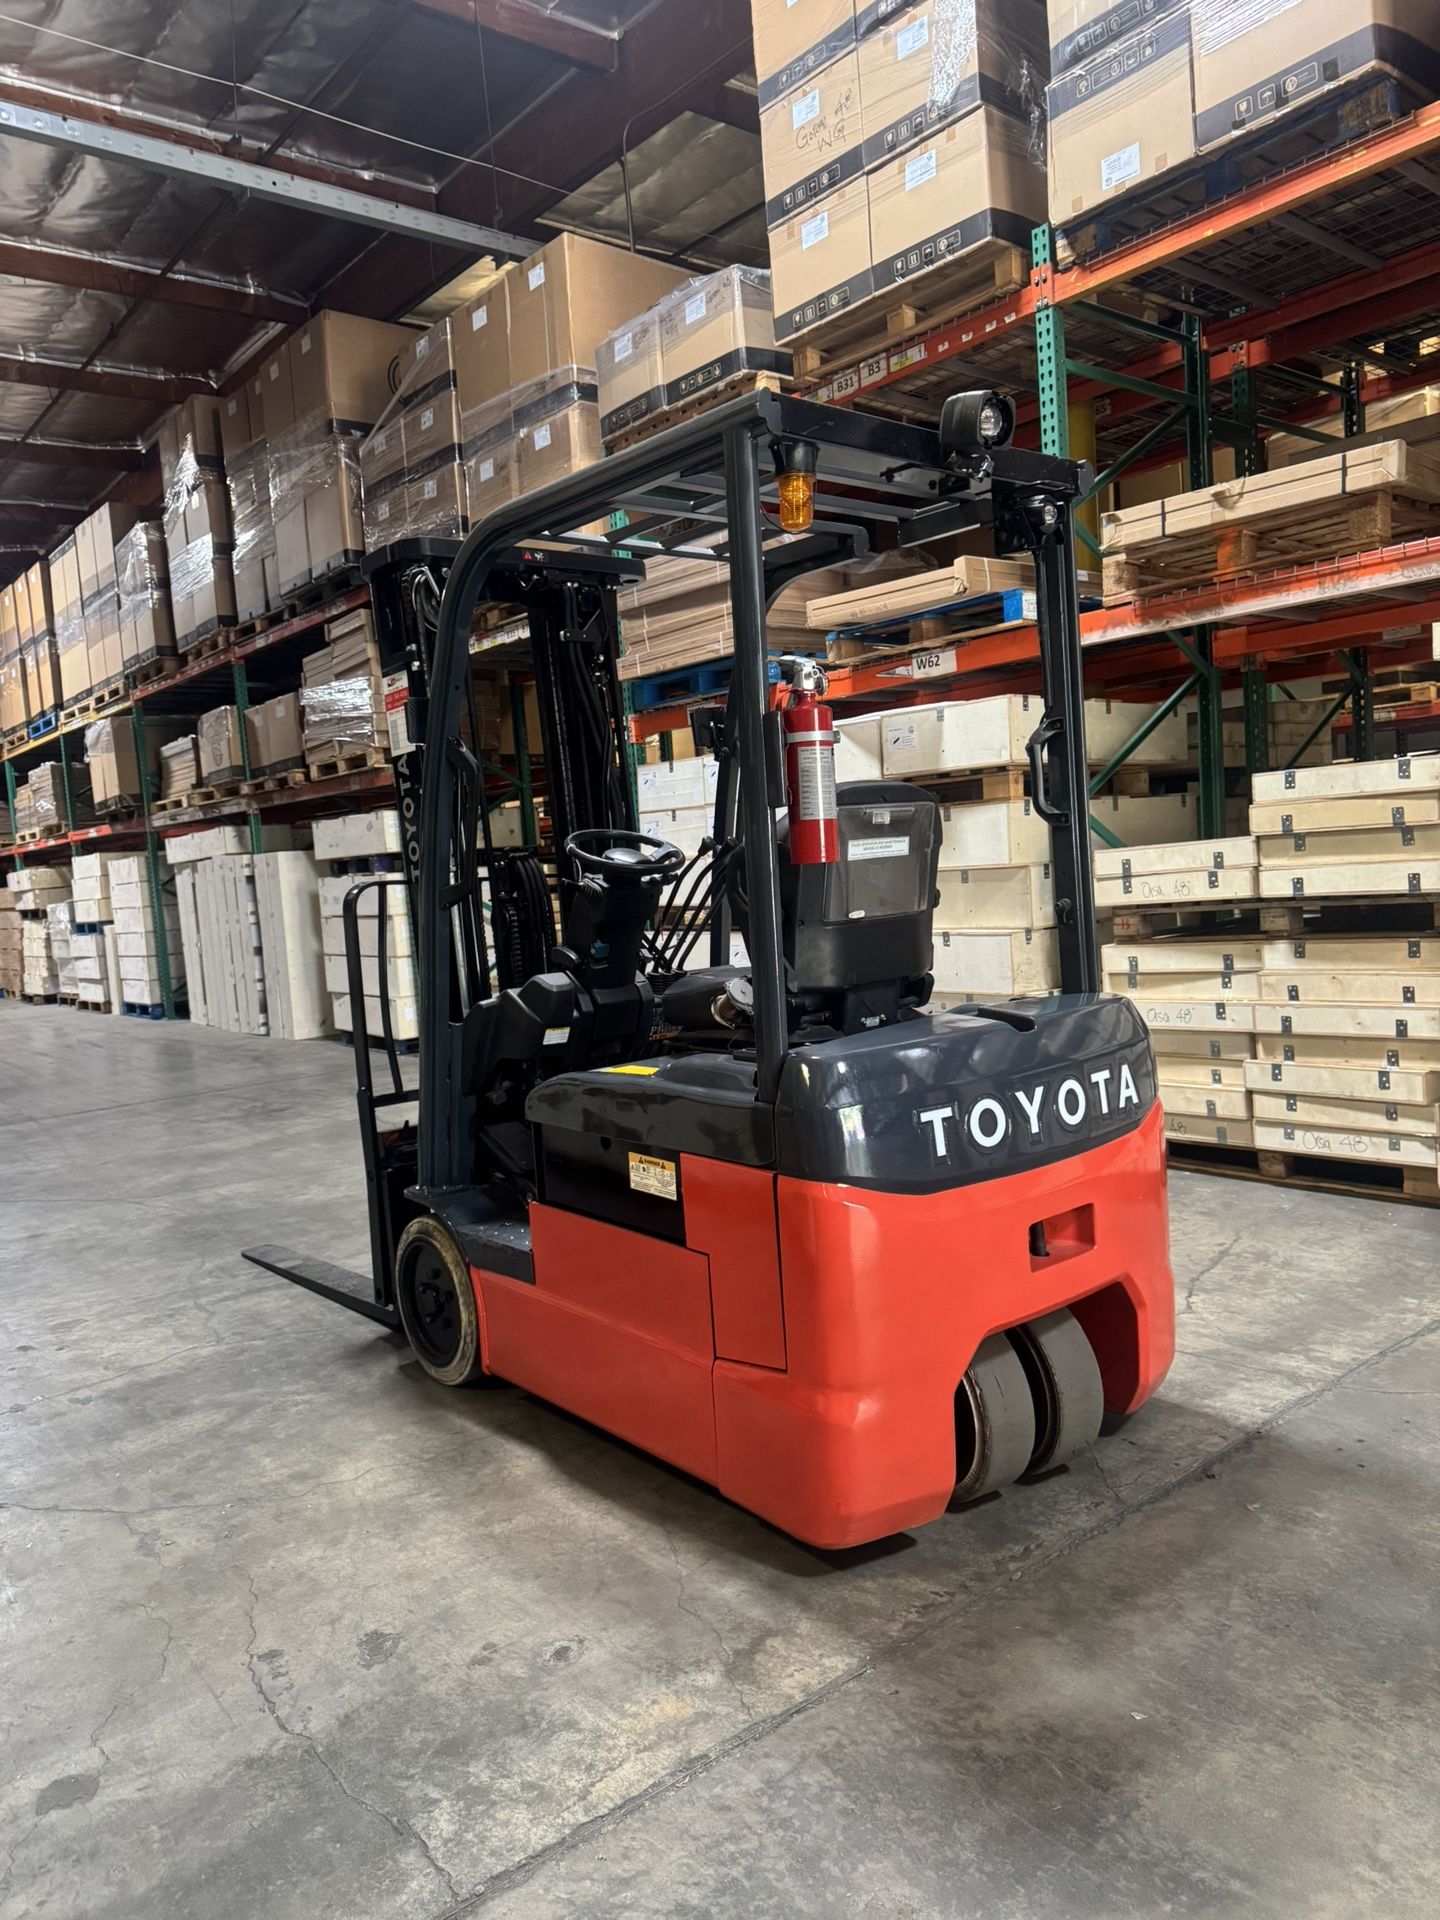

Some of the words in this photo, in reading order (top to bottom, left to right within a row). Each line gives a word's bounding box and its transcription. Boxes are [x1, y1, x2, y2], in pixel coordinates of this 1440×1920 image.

[837, 375, 855, 393] B31
[916, 654, 941, 671] W62
[397, 753, 421, 883] TOYOTA
[919, 1063, 1140, 1158] TOYOTA
